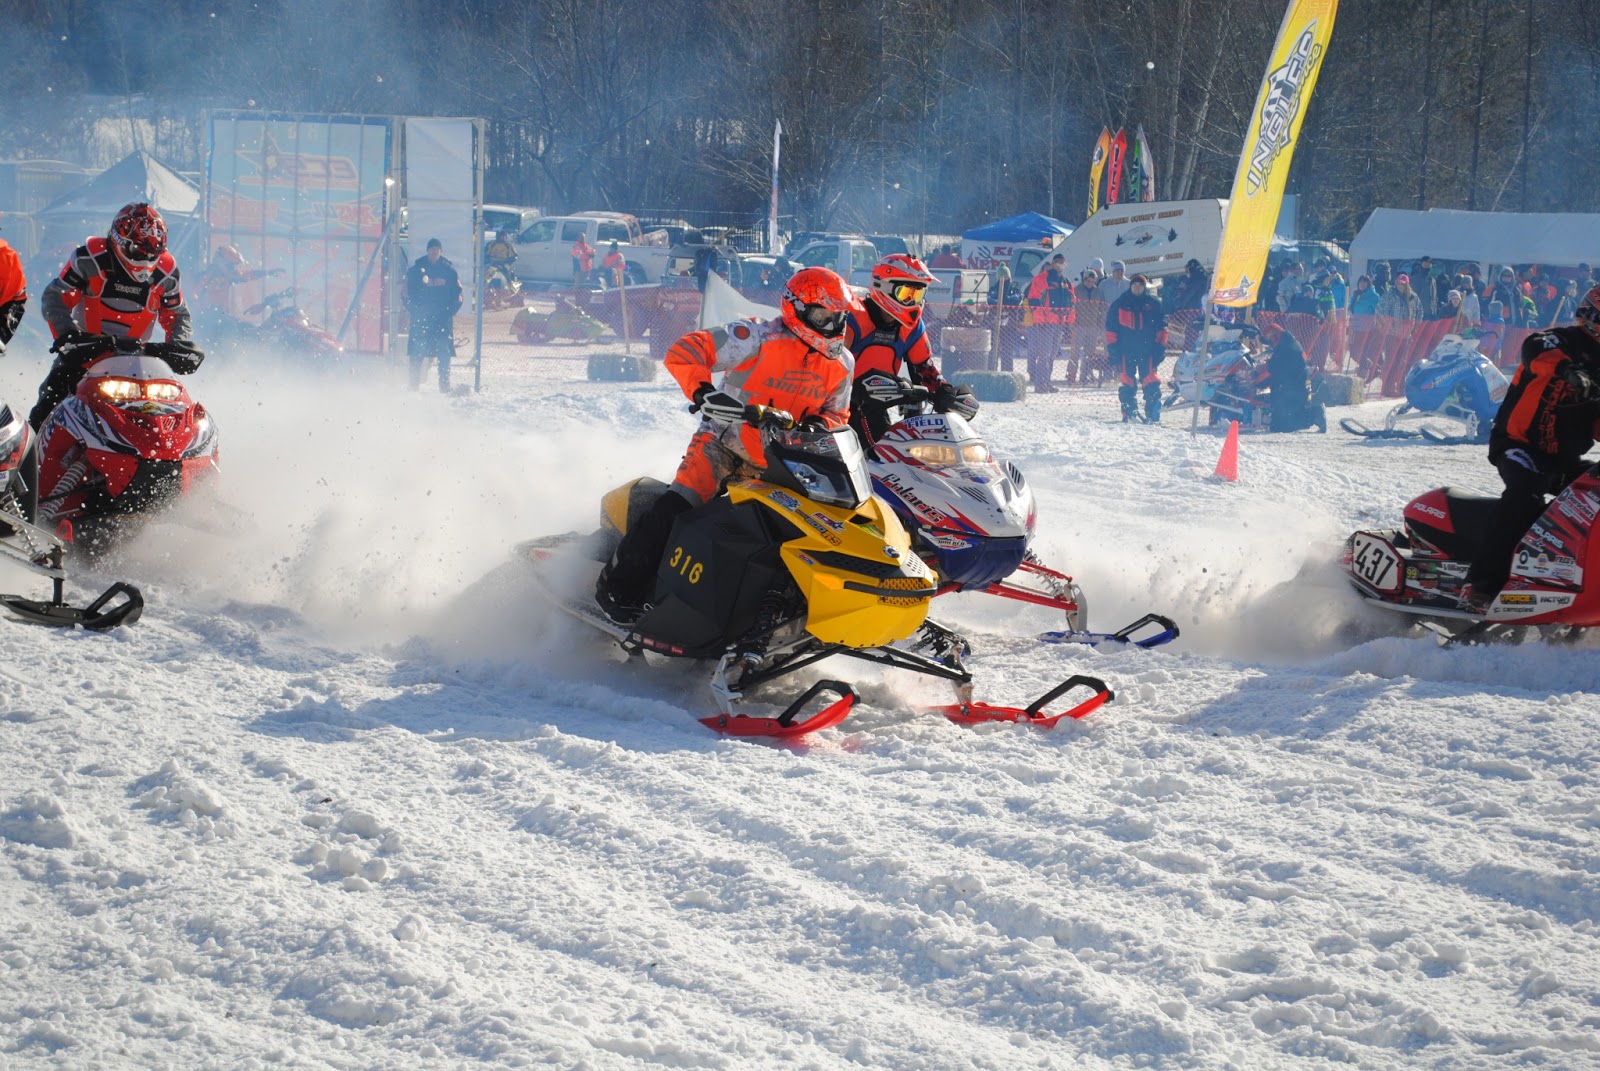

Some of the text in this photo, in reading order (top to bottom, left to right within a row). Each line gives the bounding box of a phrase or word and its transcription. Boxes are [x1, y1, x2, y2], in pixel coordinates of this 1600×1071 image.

[907, 419, 944, 429] FIELD
[880, 473, 945, 523] Polaris
[1412, 502, 1446, 519] POLARIS
[1531, 523, 1564, 549] POLARIS
[669, 546, 703, 584] 316
[1355, 542, 1395, 586] 437
